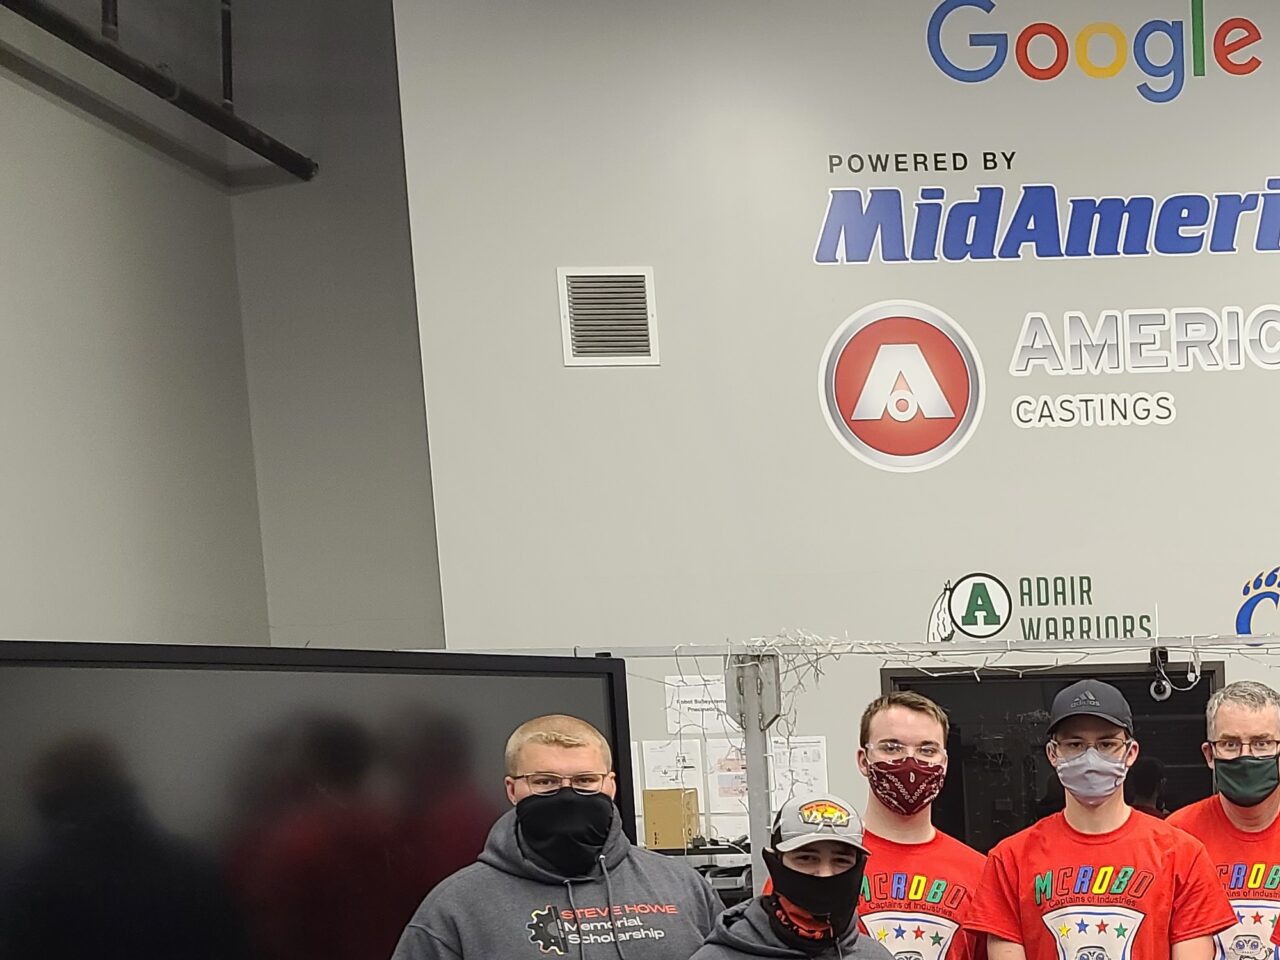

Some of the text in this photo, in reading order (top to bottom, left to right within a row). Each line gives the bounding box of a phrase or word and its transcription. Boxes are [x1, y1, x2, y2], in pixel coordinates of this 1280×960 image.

[926, 0, 1264, 103] Google
[828, 151, 1017, 174] POWERED BY
[1014, 397, 1173, 425] CASTINGS
[1019, 575, 1093, 606] ADAIR
[1019, 614, 1152, 641] WARRIORS
[1035, 865, 1155, 906] MCROBO
[560, 904, 679, 920] STEVE HOWE
[1048, 896, 1086, 908] Captains
[1096, 896, 1136, 907] Industries
[563, 916, 644, 932] Memorial
[567, 927, 665, 944] Scholarship
